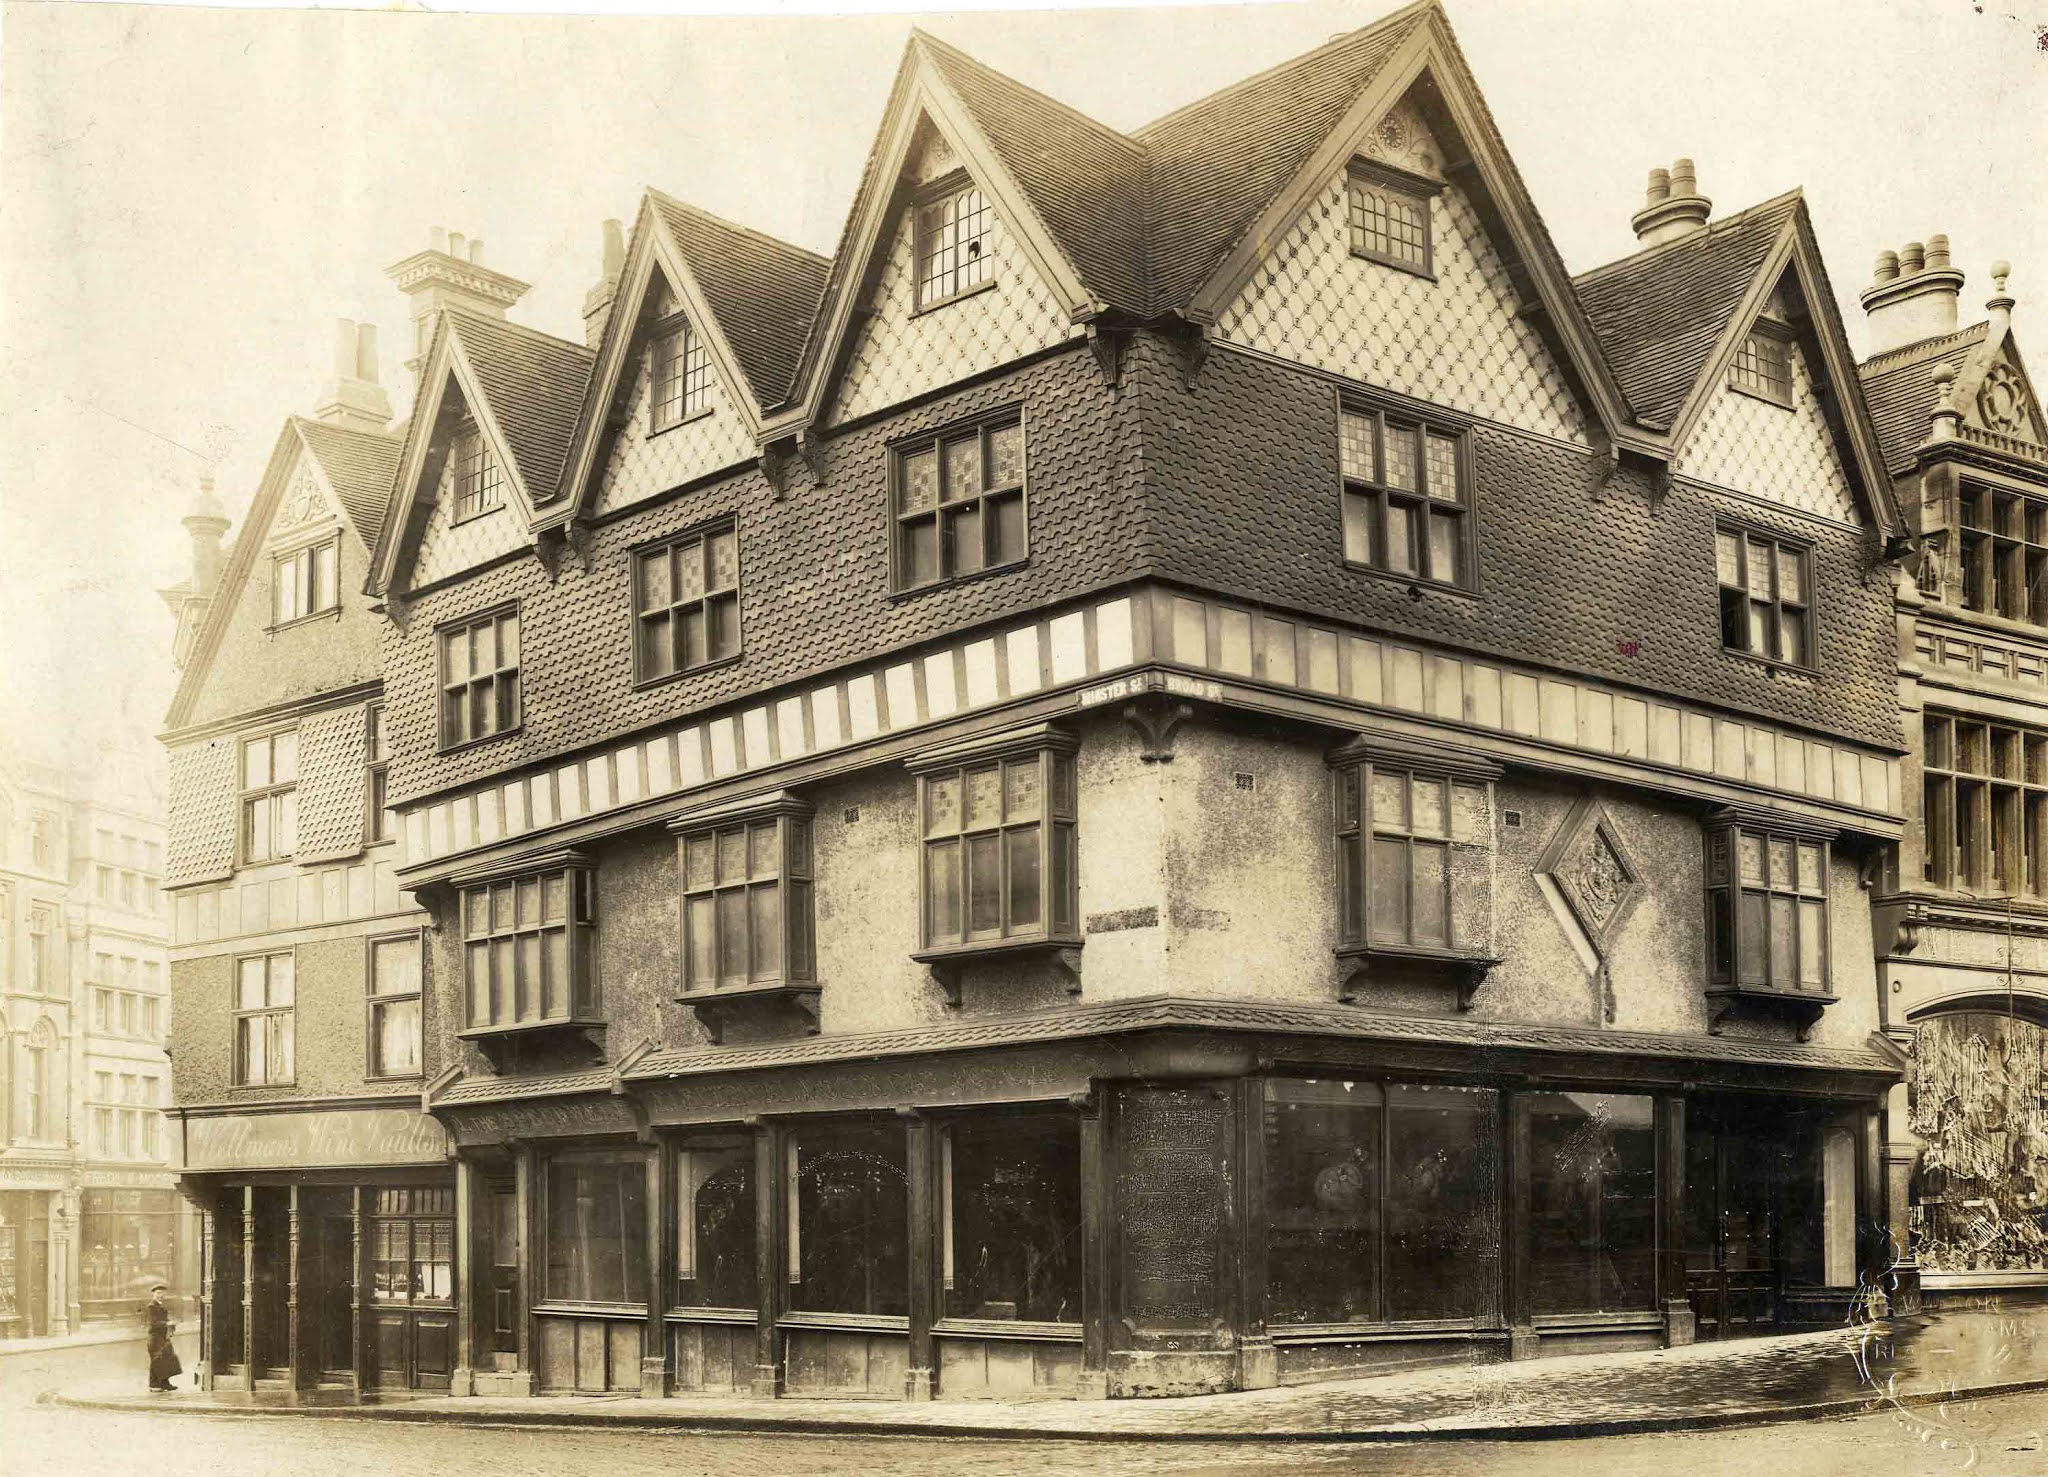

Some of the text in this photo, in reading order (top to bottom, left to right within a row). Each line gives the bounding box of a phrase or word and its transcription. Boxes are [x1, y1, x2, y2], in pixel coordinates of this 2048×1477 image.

[1081, 681, 1127, 706] MINSTER
[1167, 677, 1204, 696] BROAD
[306, 1113, 359, 1156] Wine
